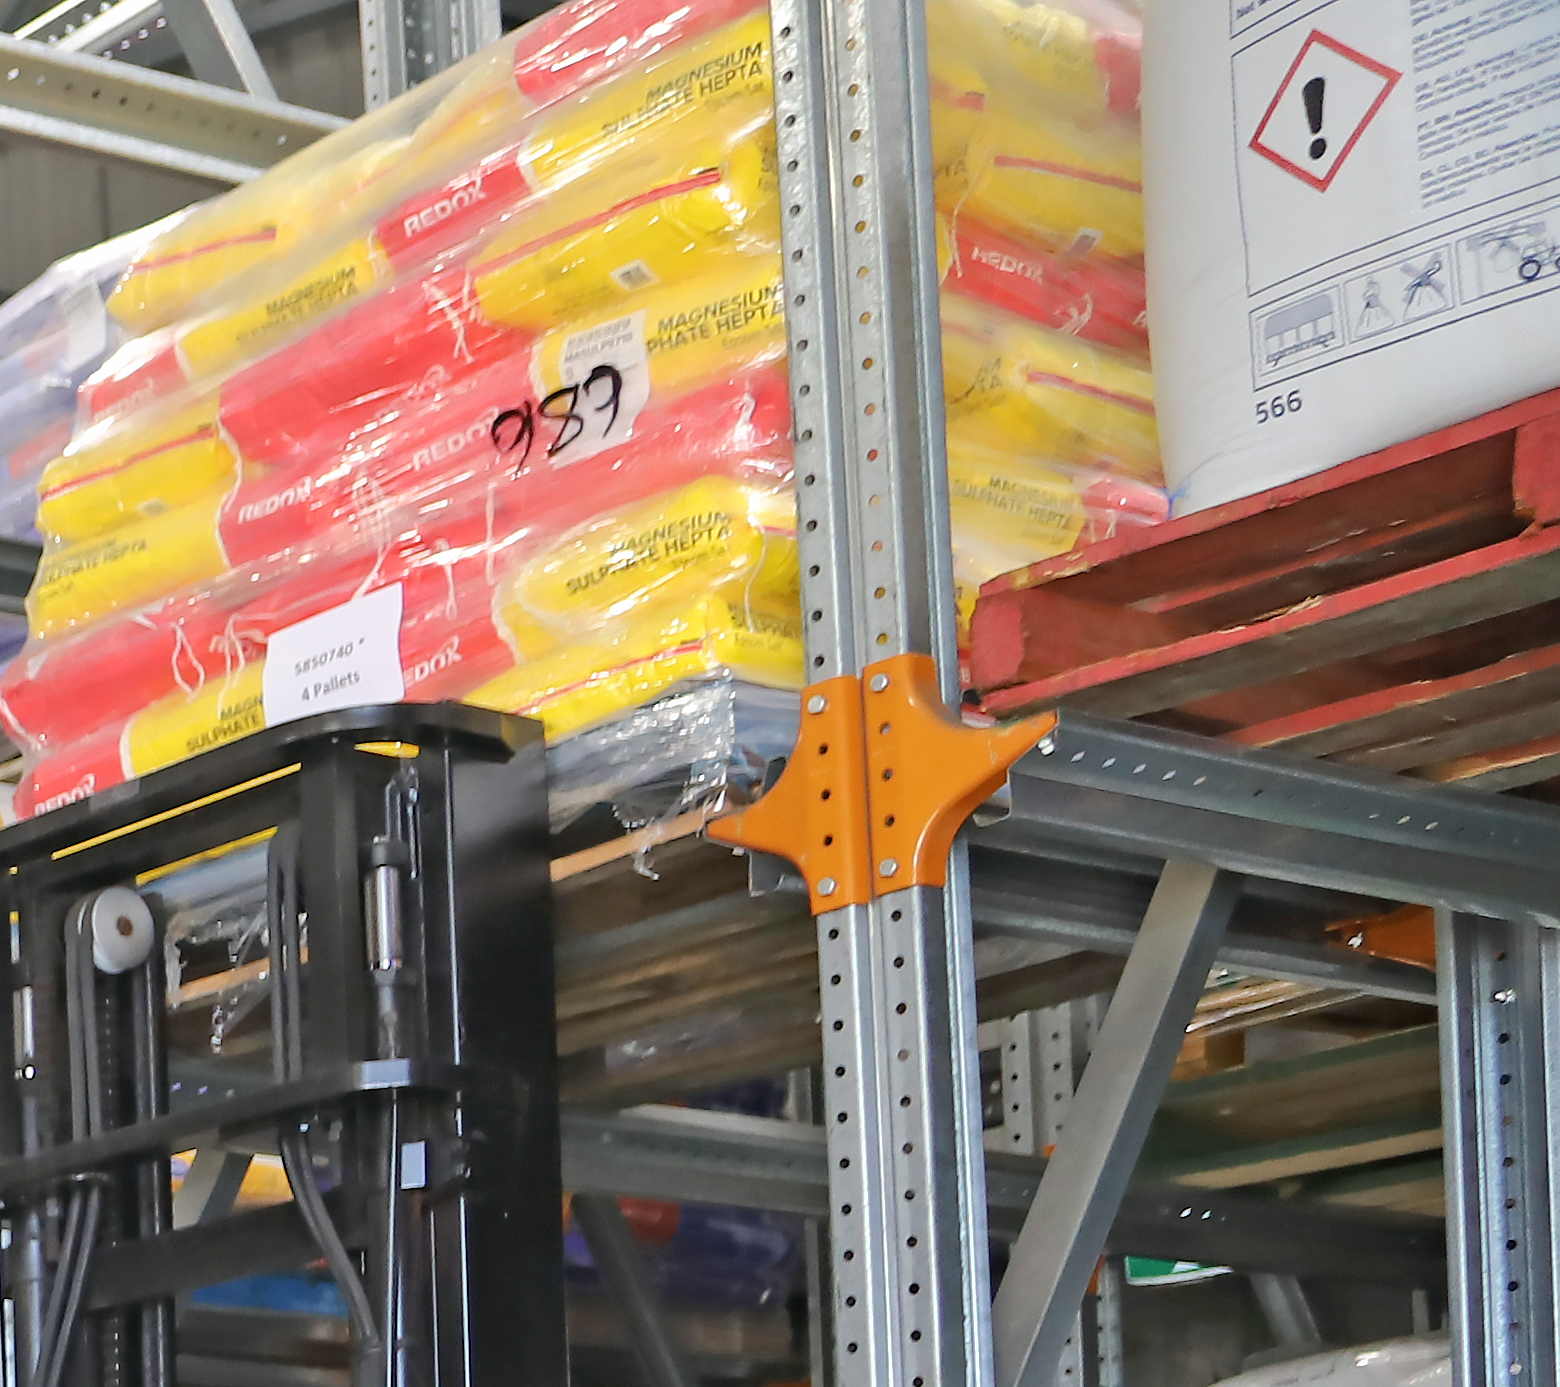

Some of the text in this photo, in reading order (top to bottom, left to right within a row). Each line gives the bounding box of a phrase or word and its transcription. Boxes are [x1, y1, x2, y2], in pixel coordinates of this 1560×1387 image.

[646, 43, 763, 99] MAGNESIUM
[699, 63, 763, 97] HEPTA
[404, 177, 487, 238] REDOX
[646, 324, 710, 353] PHATE
[1255, 389, 1303, 424] 566
[665, 525, 730, 551] HEPTA
[294, 641, 354, 675] 5850740
[301, 670, 360, 702] 4 Pallets
[221, 695, 264, 720] MAGN
[186, 713, 262, 751] SULPHATE
